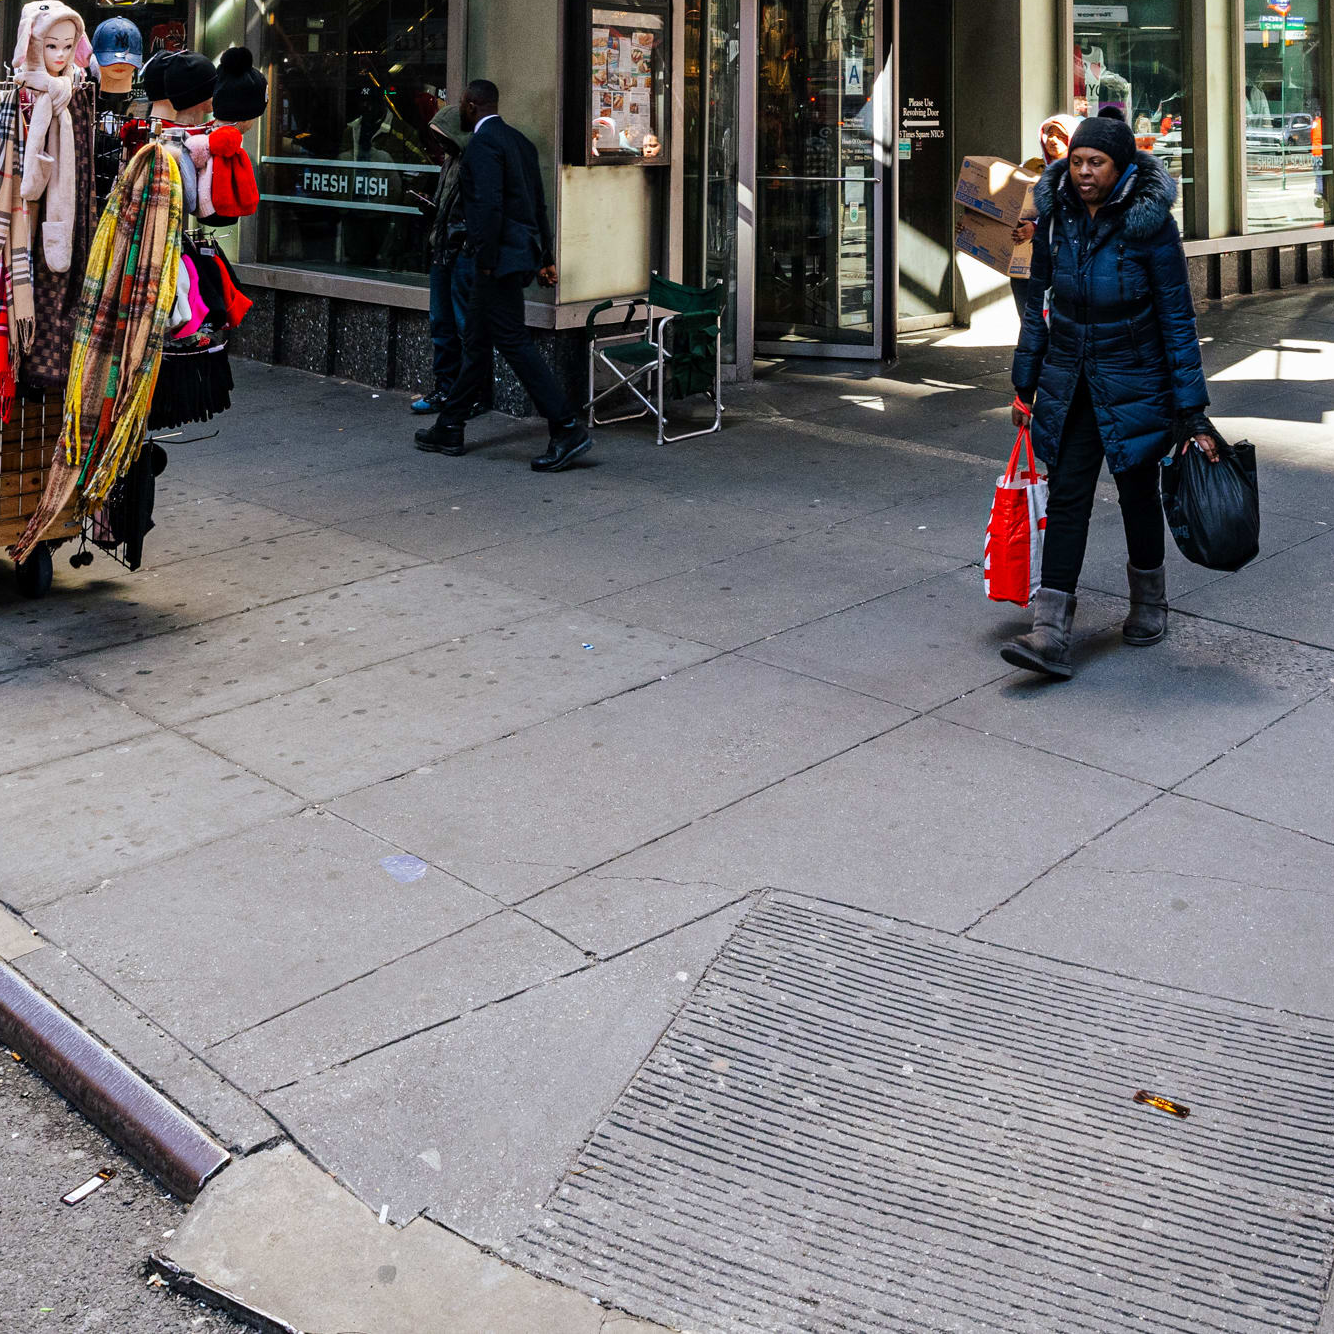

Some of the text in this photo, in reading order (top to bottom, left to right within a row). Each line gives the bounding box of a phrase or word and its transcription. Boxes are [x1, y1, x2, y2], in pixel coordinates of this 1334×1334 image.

[848, 64, 861, 85] A
[908, 97, 934, 108] Please Use
[902, 107, 940, 118] Revolving Door
[902, 130, 916, 139] Times
[915, 130, 930, 140] Square
[303, 172, 389, 197] FRESH FISH
